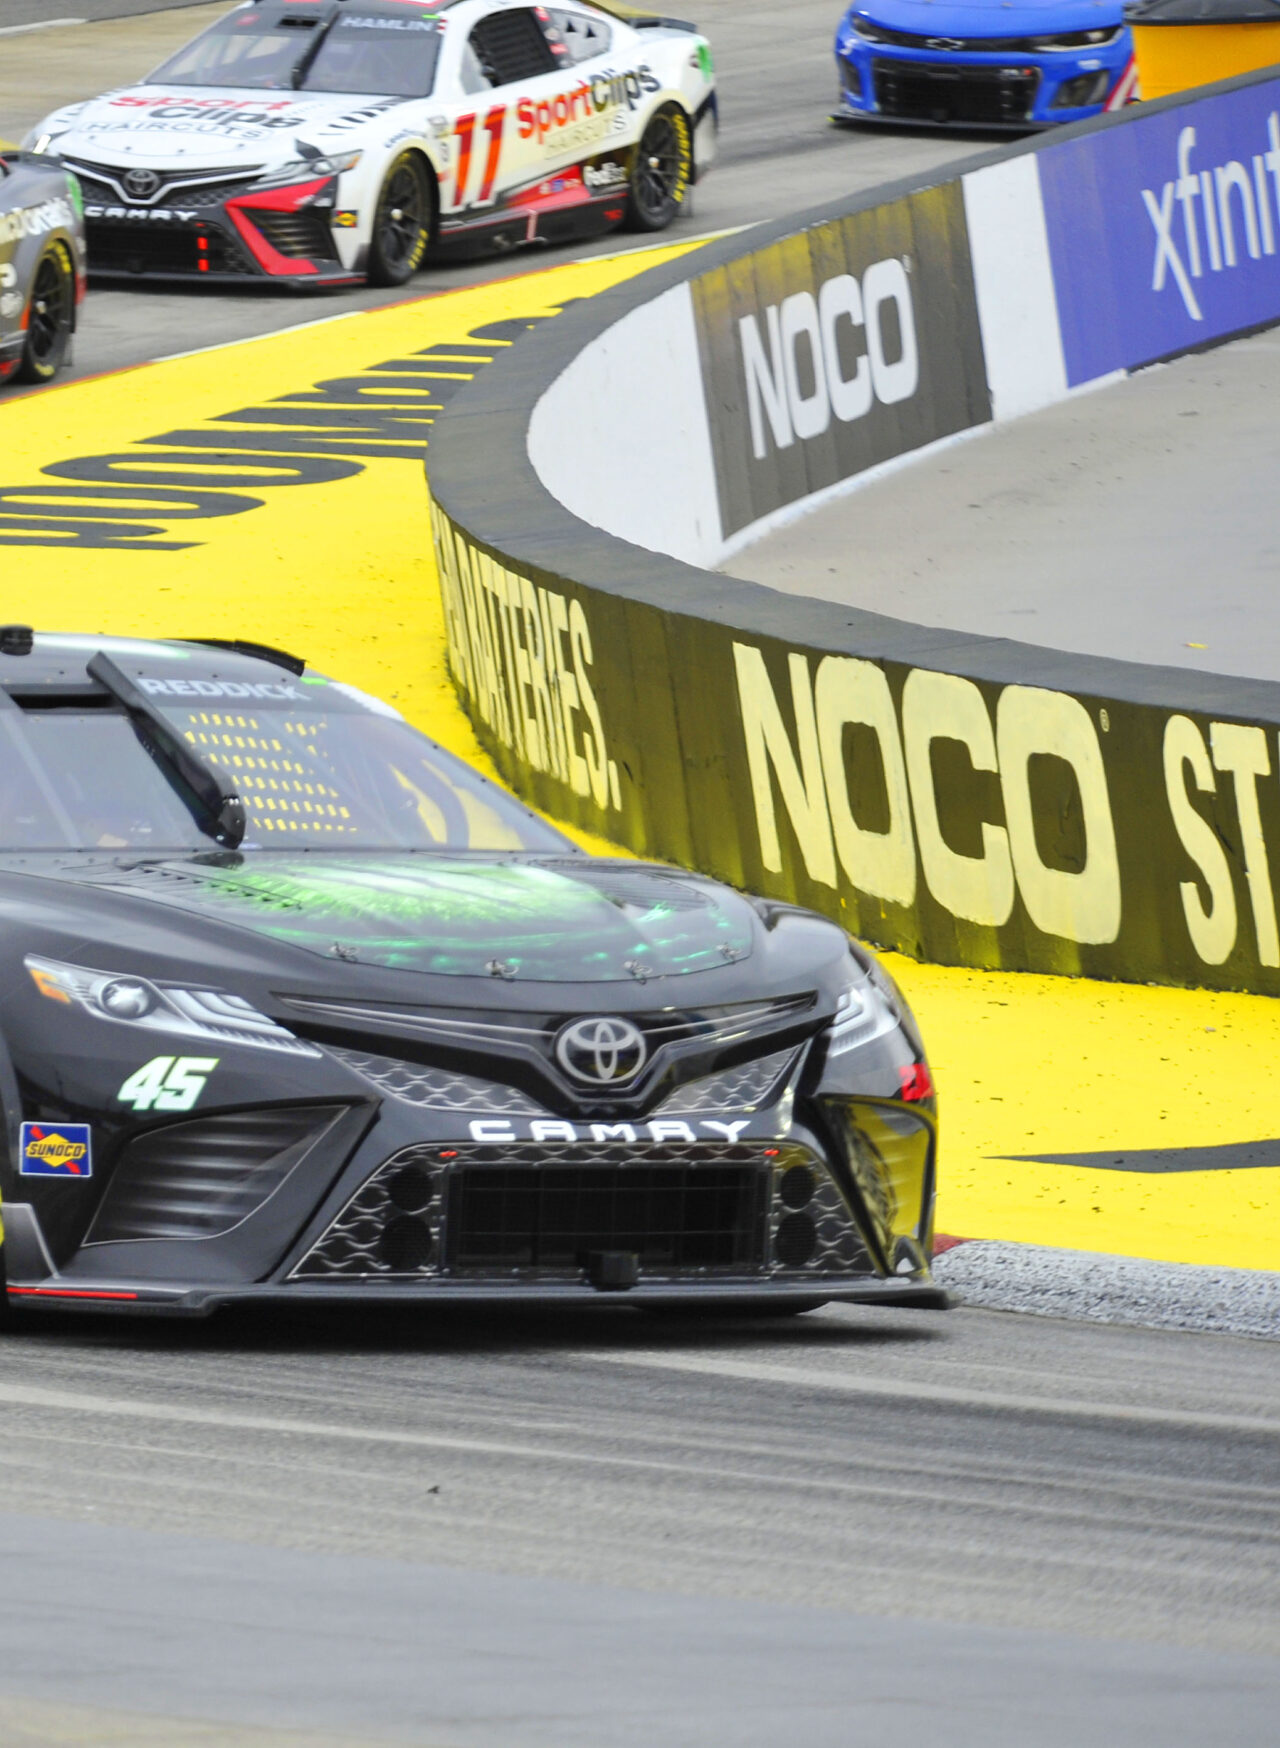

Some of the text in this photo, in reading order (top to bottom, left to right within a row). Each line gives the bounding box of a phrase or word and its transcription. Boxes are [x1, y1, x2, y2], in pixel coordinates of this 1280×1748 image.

[342, 15, 434, 32] HAMLIN
[109, 97, 292, 110] Sport
[149, 106, 306, 128] Clips
[87, 122, 265, 138] HAIRCUTS
[452, 103, 508, 207] 11
[85, 205, 200, 222] CAMRY
[739, 258, 919, 459] NOCO
[136, 677, 312, 701] REDDICK
[733, 641, 1280, 969] NOCO ST
[117, 1055, 220, 1110] 45
[469, 1120, 751, 1143] CAMRY
[28, 1143, 84, 1158] SUNOCO
